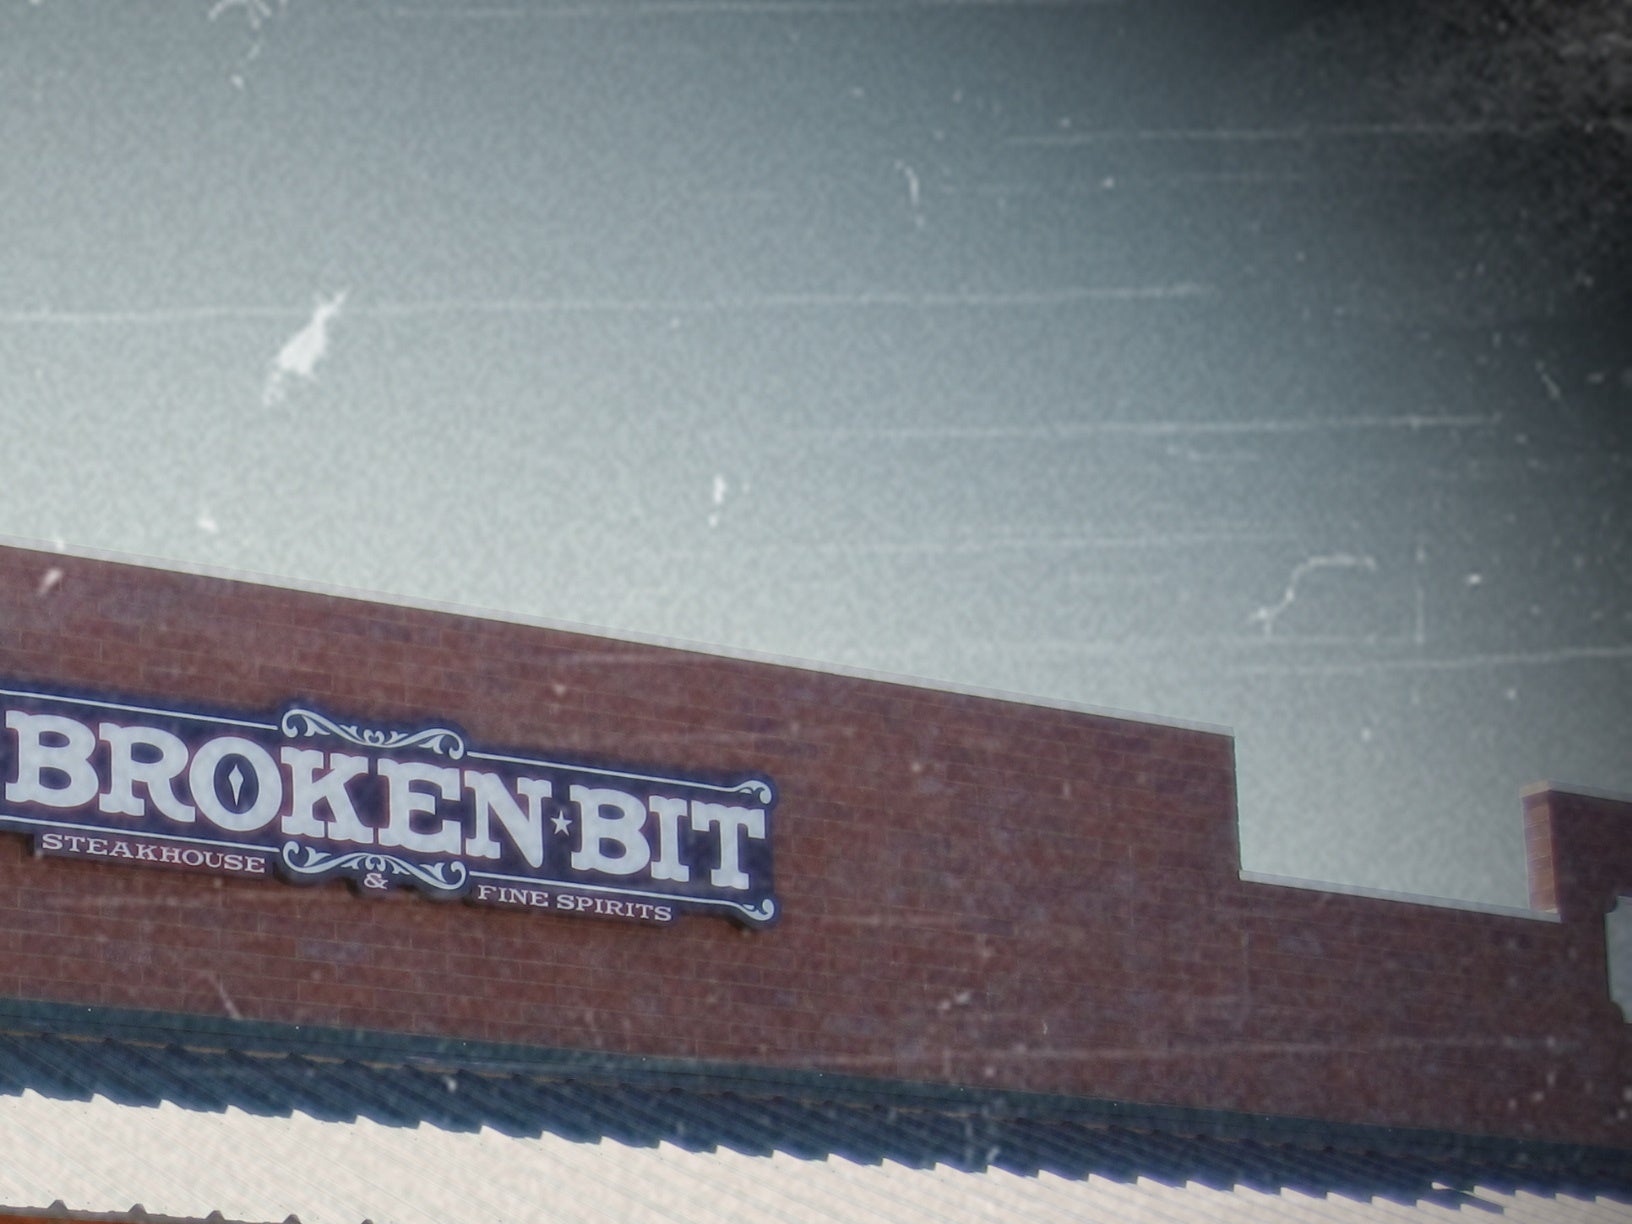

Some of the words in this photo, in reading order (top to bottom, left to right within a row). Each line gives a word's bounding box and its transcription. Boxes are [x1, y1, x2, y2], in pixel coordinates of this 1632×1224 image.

[4, 708, 553, 870] BROKEN
[569, 784, 766, 890] BIT
[41, 833, 266, 875] STEAKHOUSE
[362, 871, 389, 891] &
[477, 884, 550, 909] FINE
[556, 893, 673, 923] SPIRITS
